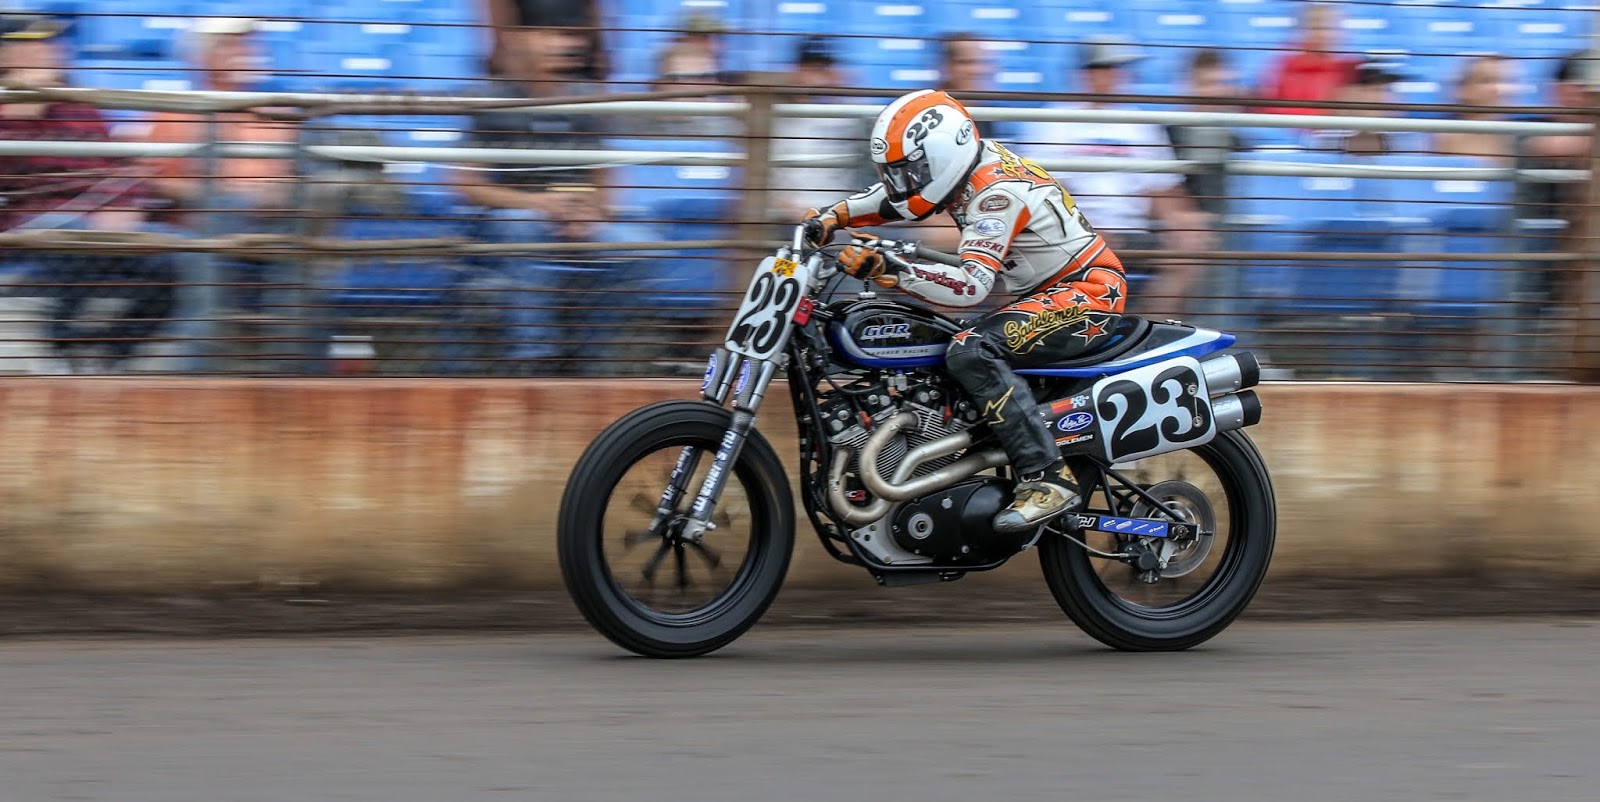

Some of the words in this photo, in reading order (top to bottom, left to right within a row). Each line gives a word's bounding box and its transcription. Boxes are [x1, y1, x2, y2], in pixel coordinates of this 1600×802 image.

[906, 108, 944, 146] 23
[727, 271, 800, 354] 23
[862, 323, 911, 341] GCR
[1003, 304, 1091, 348] Saddlemen
[1097, 365, 1211, 460] 23
